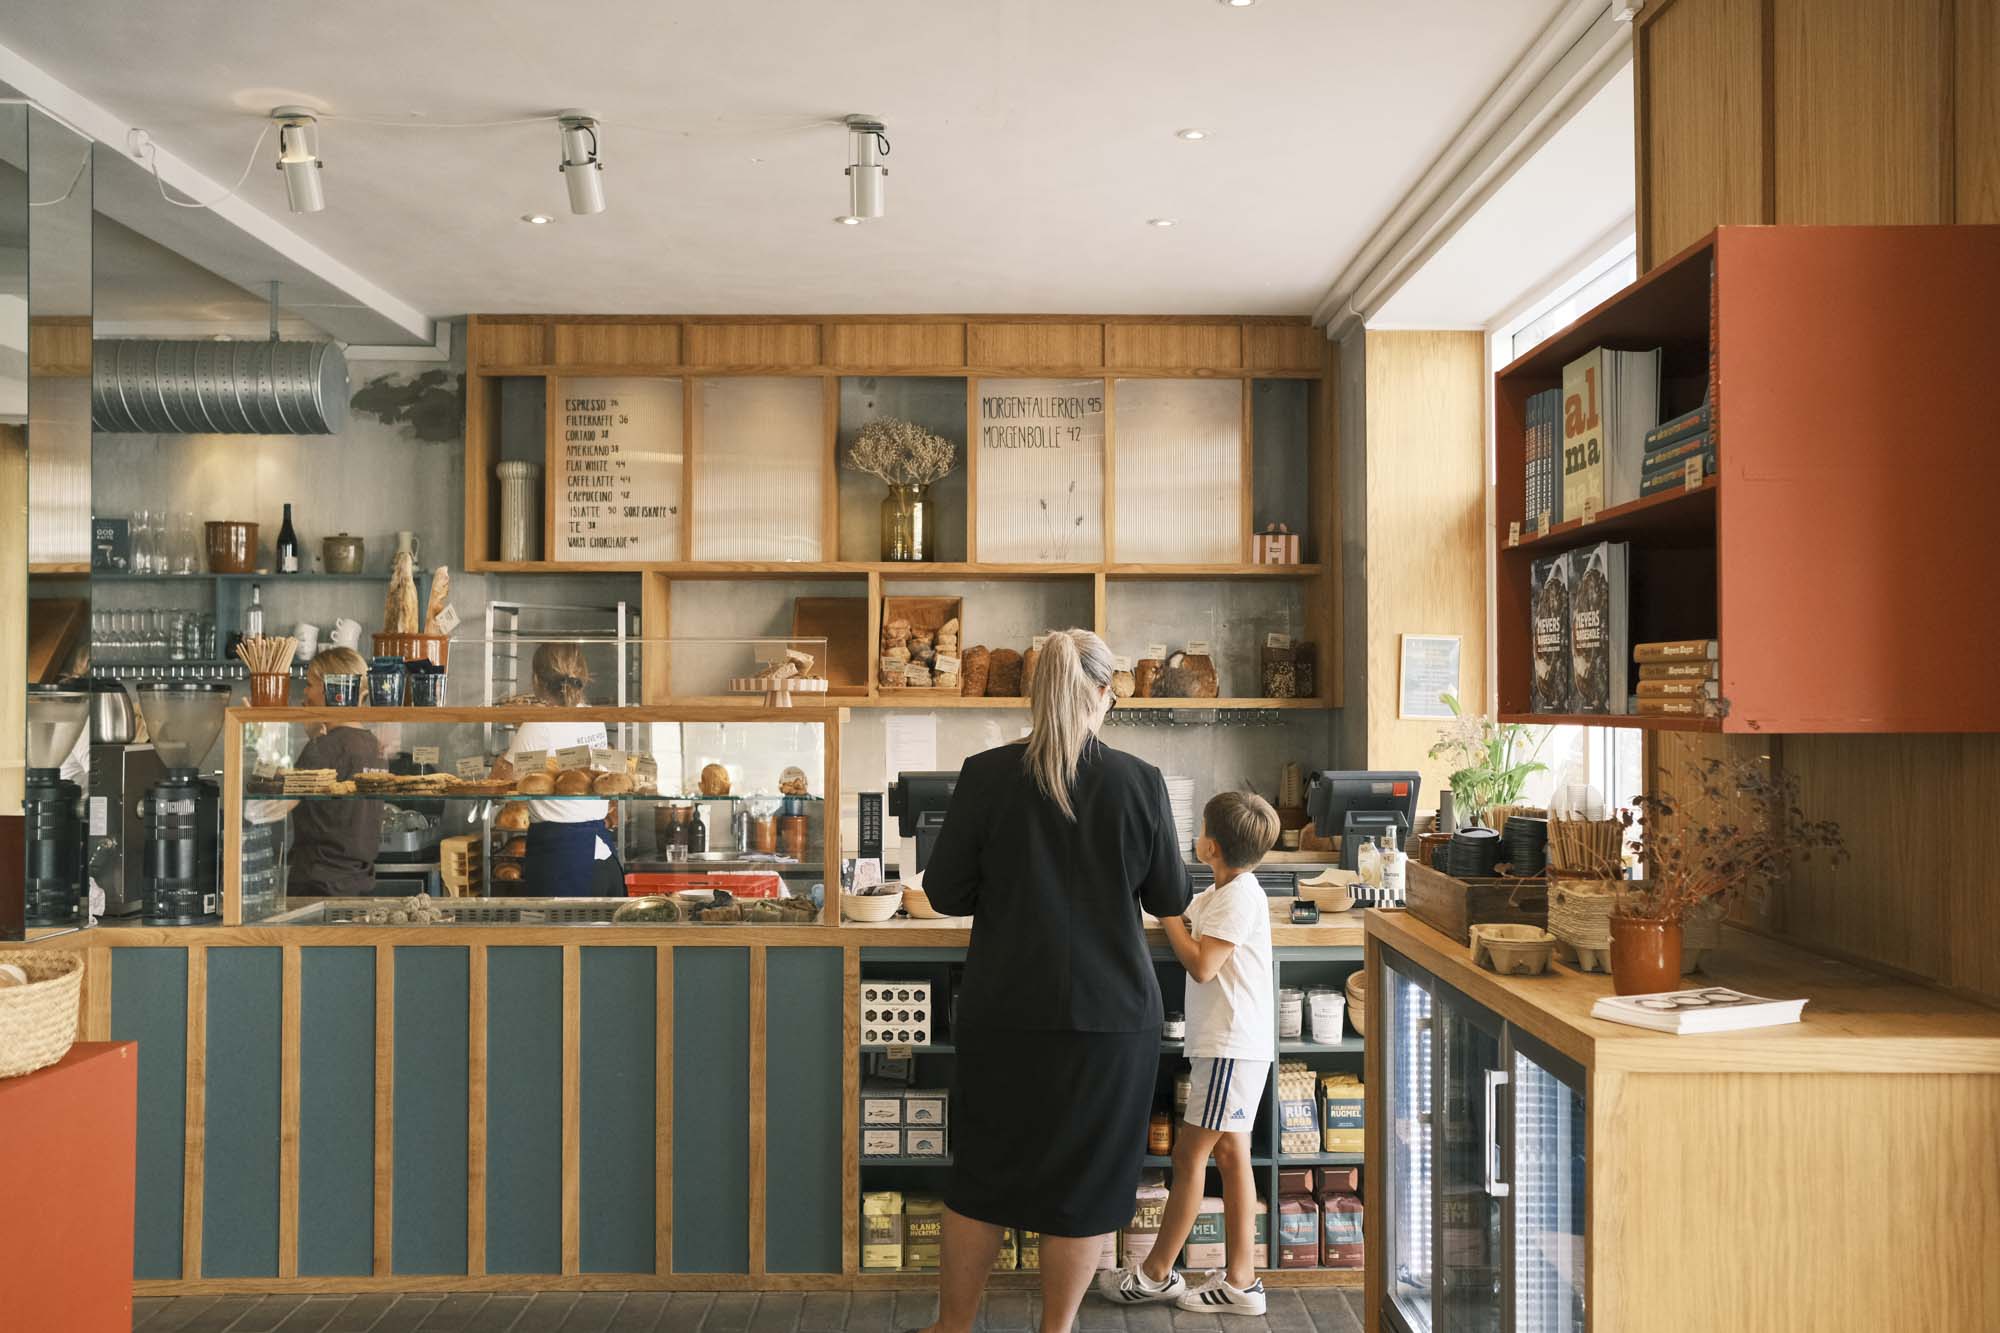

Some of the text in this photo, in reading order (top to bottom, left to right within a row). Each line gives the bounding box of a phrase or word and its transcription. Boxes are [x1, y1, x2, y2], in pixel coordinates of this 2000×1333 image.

[565, 399, 606, 412] ESPRESSO
[982, 396, 1102, 420] MORGENTALLERKEN 95
[1565, 367, 1599, 439] al
[566, 414, 629, 427] FILTERKAFFE 36
[565, 430, 596, 441] CORTADO
[983, 425, 1081, 449] MORGENBOLLE 42
[566, 444, 610, 457] AMERICANO
[1565, 438, 1600, 476] ma
[566, 459, 582, 472] FLAT
[584, 459, 608, 472] WHITE
[592, 475, 615, 488] LATTE
[567, 491, 613, 503] CAPPUCCINO
[570, 506, 600, 518] ISLATTE
[623, 506, 640, 518] SORT
[568, 521, 582, 534] TE
[589, 537, 628, 549] CHOKOLADE
[1576, 610, 1600, 629] MEYERS
[1285, 1105, 1312, 1118] RUG
[1331, 1110, 1362, 1118] RUGMEL
[1192, 1224, 1218, 1236] MEL
